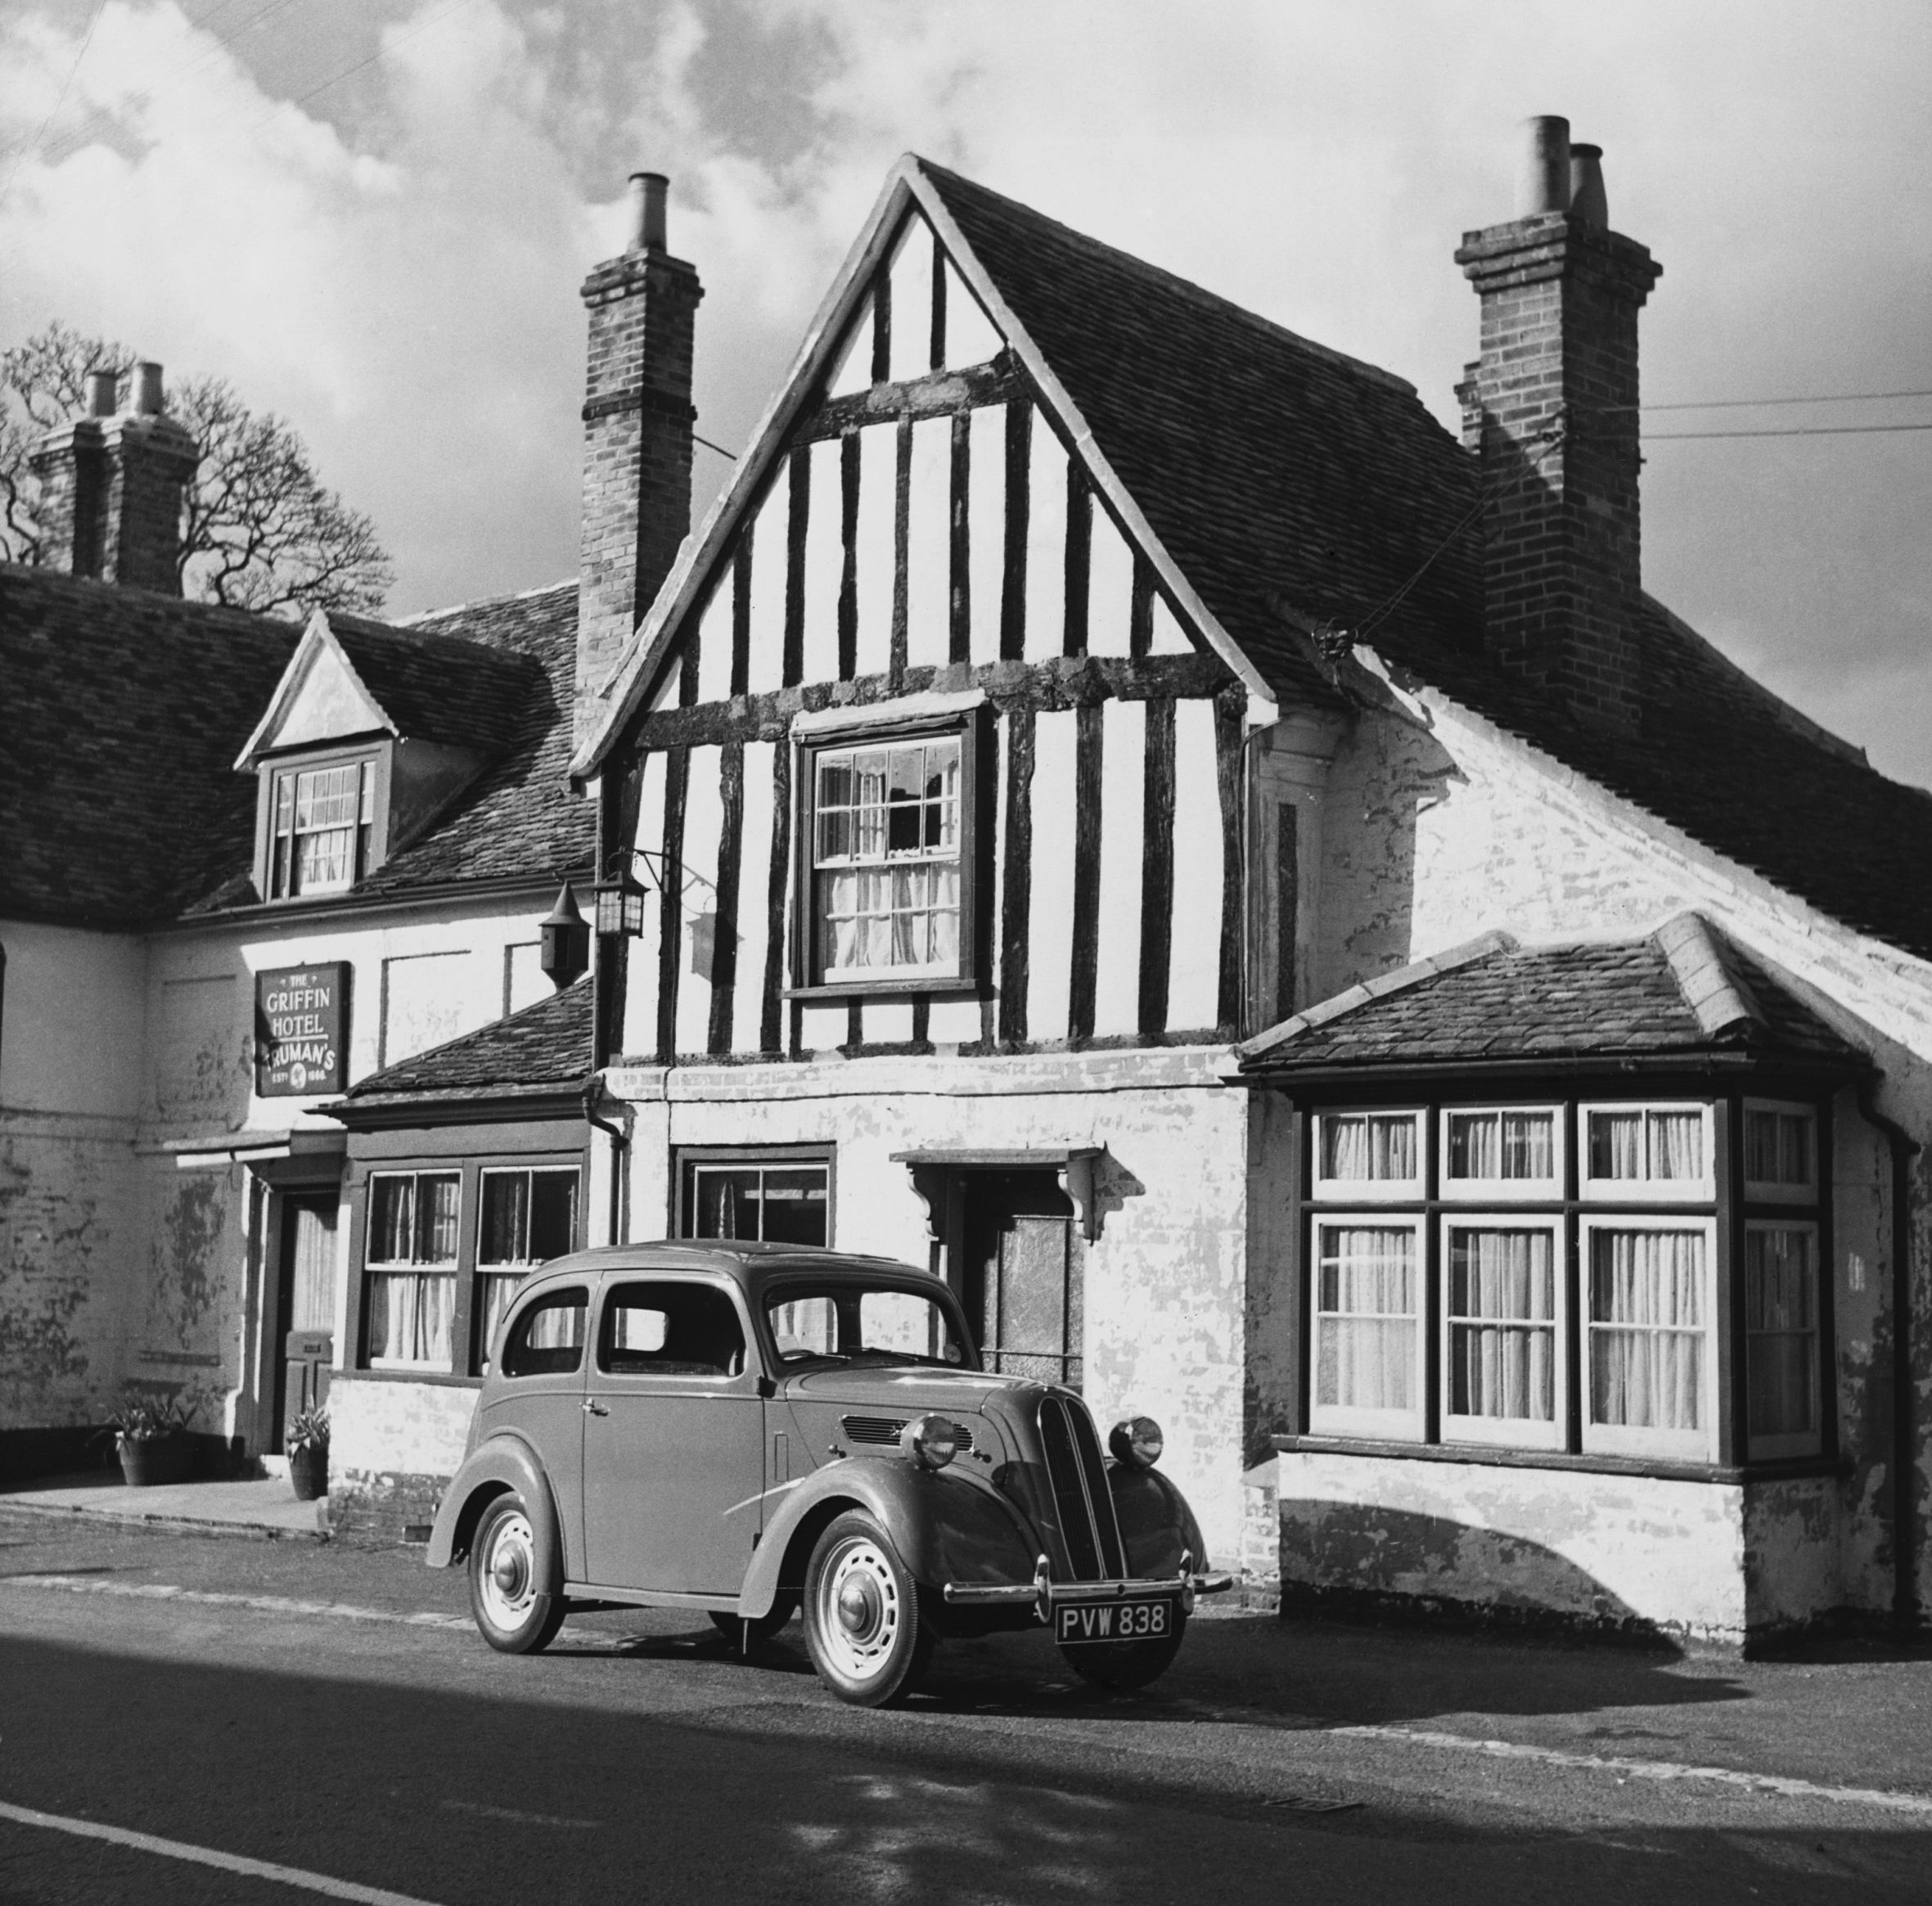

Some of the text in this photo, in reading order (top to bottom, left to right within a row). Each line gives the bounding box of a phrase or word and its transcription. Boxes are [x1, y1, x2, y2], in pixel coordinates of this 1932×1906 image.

[290, 974, 308, 988] THE
[267, 987, 331, 1013] GRIFFIN
[272, 1014, 324, 1037] HOTEL
[1063, 1605, 1164, 1638] PVW 838
